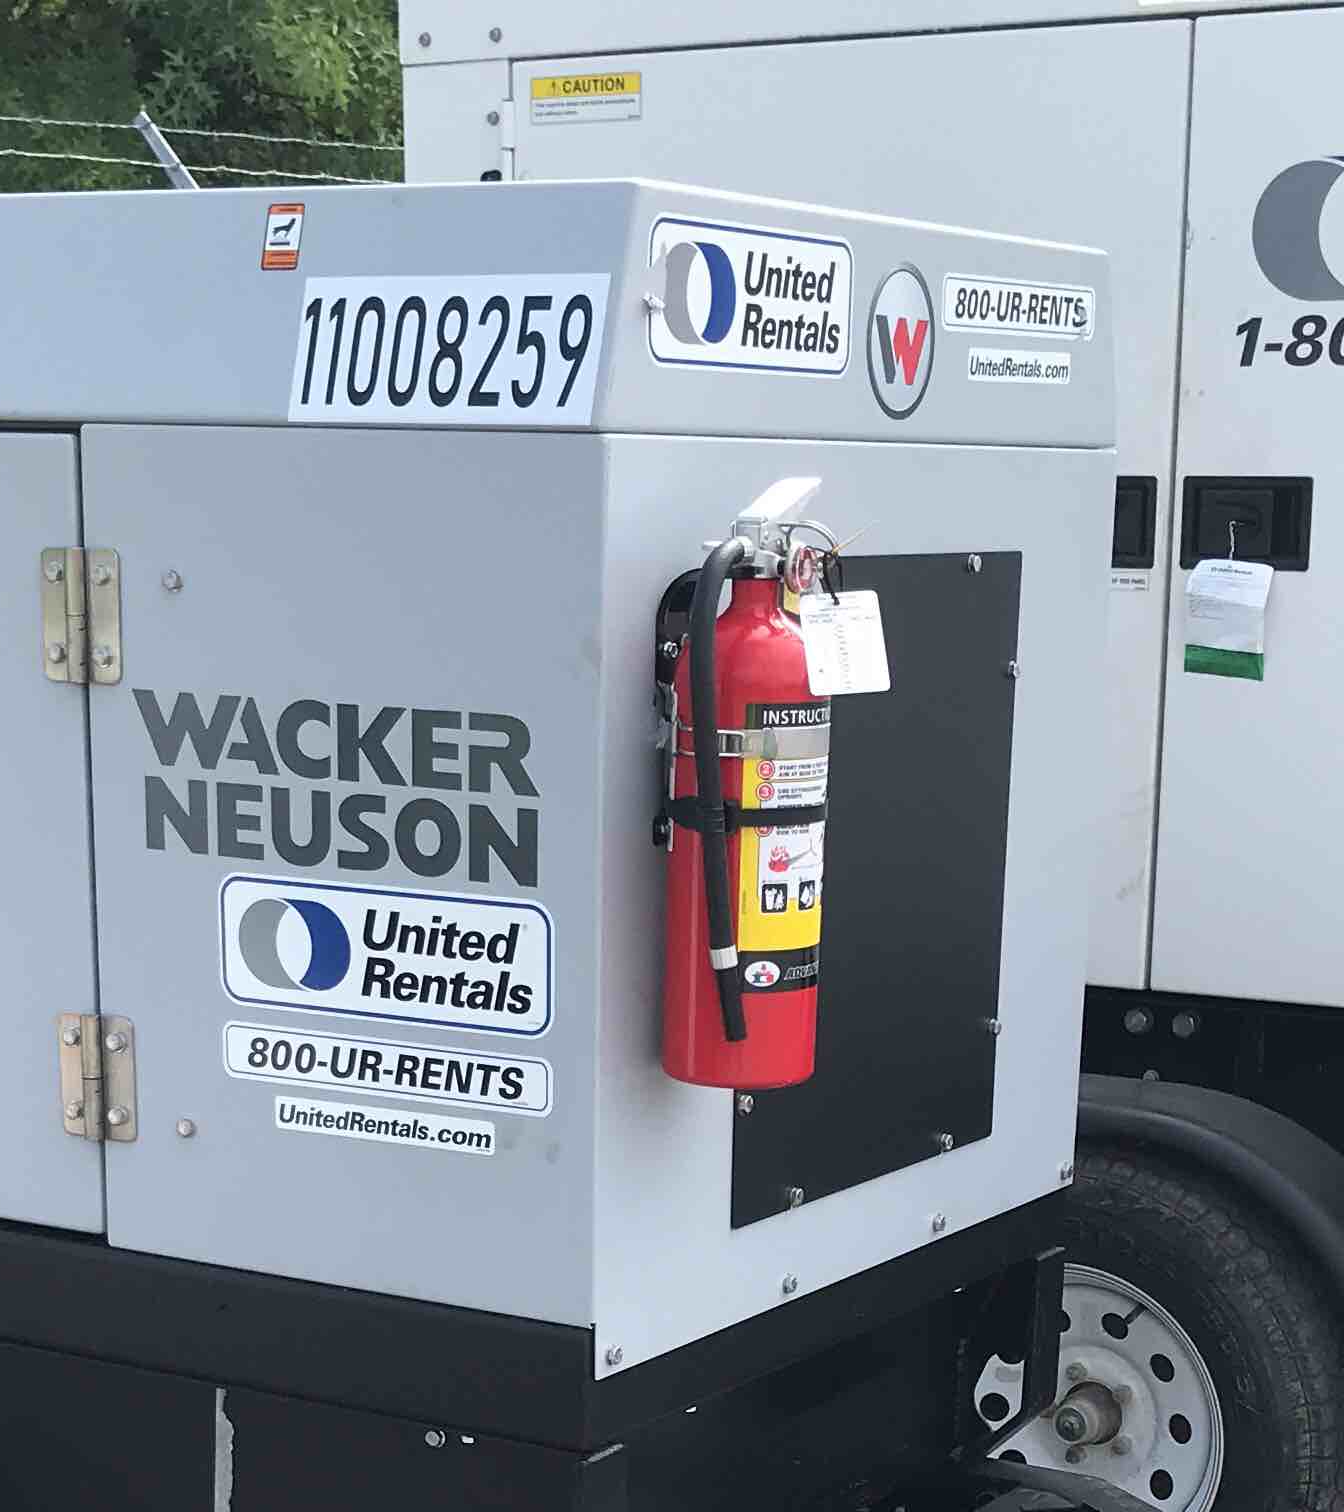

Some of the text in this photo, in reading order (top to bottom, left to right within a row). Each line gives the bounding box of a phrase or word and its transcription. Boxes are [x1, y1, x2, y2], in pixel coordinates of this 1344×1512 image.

[562, 77, 625, 94] CAUTION
[744, 250, 836, 304] United
[740, 303, 840, 355] Rentals
[955, 286, 1088, 328] 800-UR-RENTS
[300, 294, 593, 408] 11008259
[968, 355, 1069, 380] UnitedRentals.com
[132, 688, 540, 798] WACKER
[144, 775, 539, 888] NEUSON
[362, 908, 521, 965] United
[360, 957, 534, 1016] Rentals
[247, 1036, 525, 1101] 800-UR-RENTS
[278, 1103, 492, 1150] UnitedRentals.com
